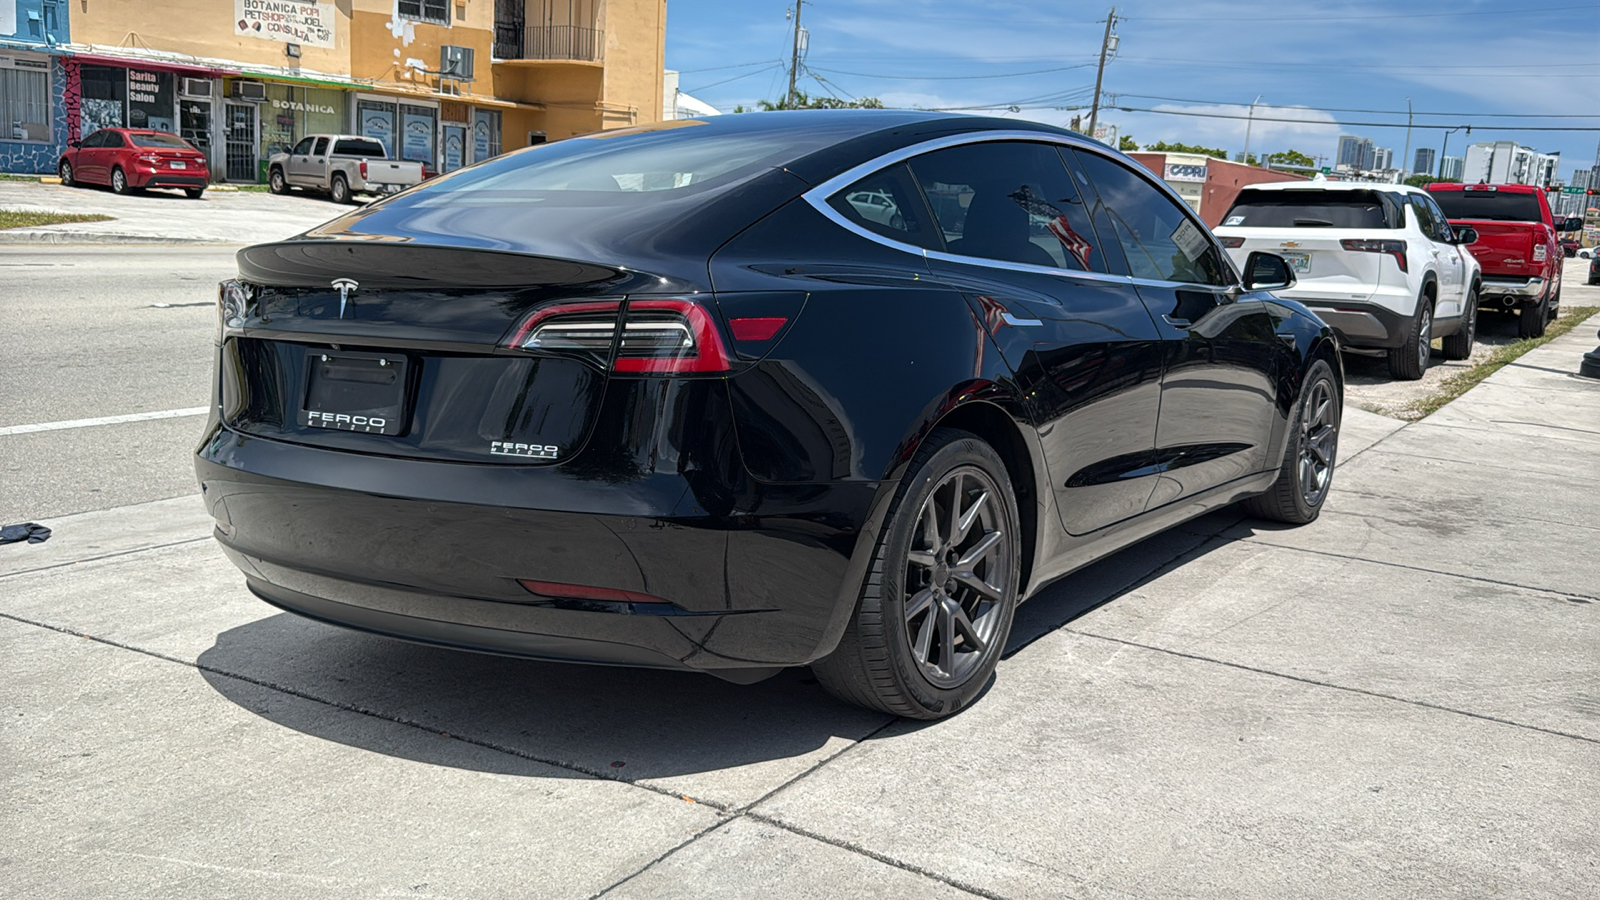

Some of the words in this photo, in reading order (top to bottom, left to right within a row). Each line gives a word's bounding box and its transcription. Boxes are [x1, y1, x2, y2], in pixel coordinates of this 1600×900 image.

[244, 0, 297, 14] BOTANICA
[300, 6, 320, 17] POPI
[302, 17, 323, 28] JOEL
[130, 70, 156, 82] Sarita
[130, 81, 159, 93] Beauty
[130, 91, 155, 103] Salon
[272, 99, 335, 114] BOTANICA
[1170, 164, 1207, 178] CAPRI
[308, 411, 386, 427] FERCO
[308, 420, 385, 434] MOTORS
[490, 447, 558, 457] MOTORS
[491, 441, 558, 452] FERCO
